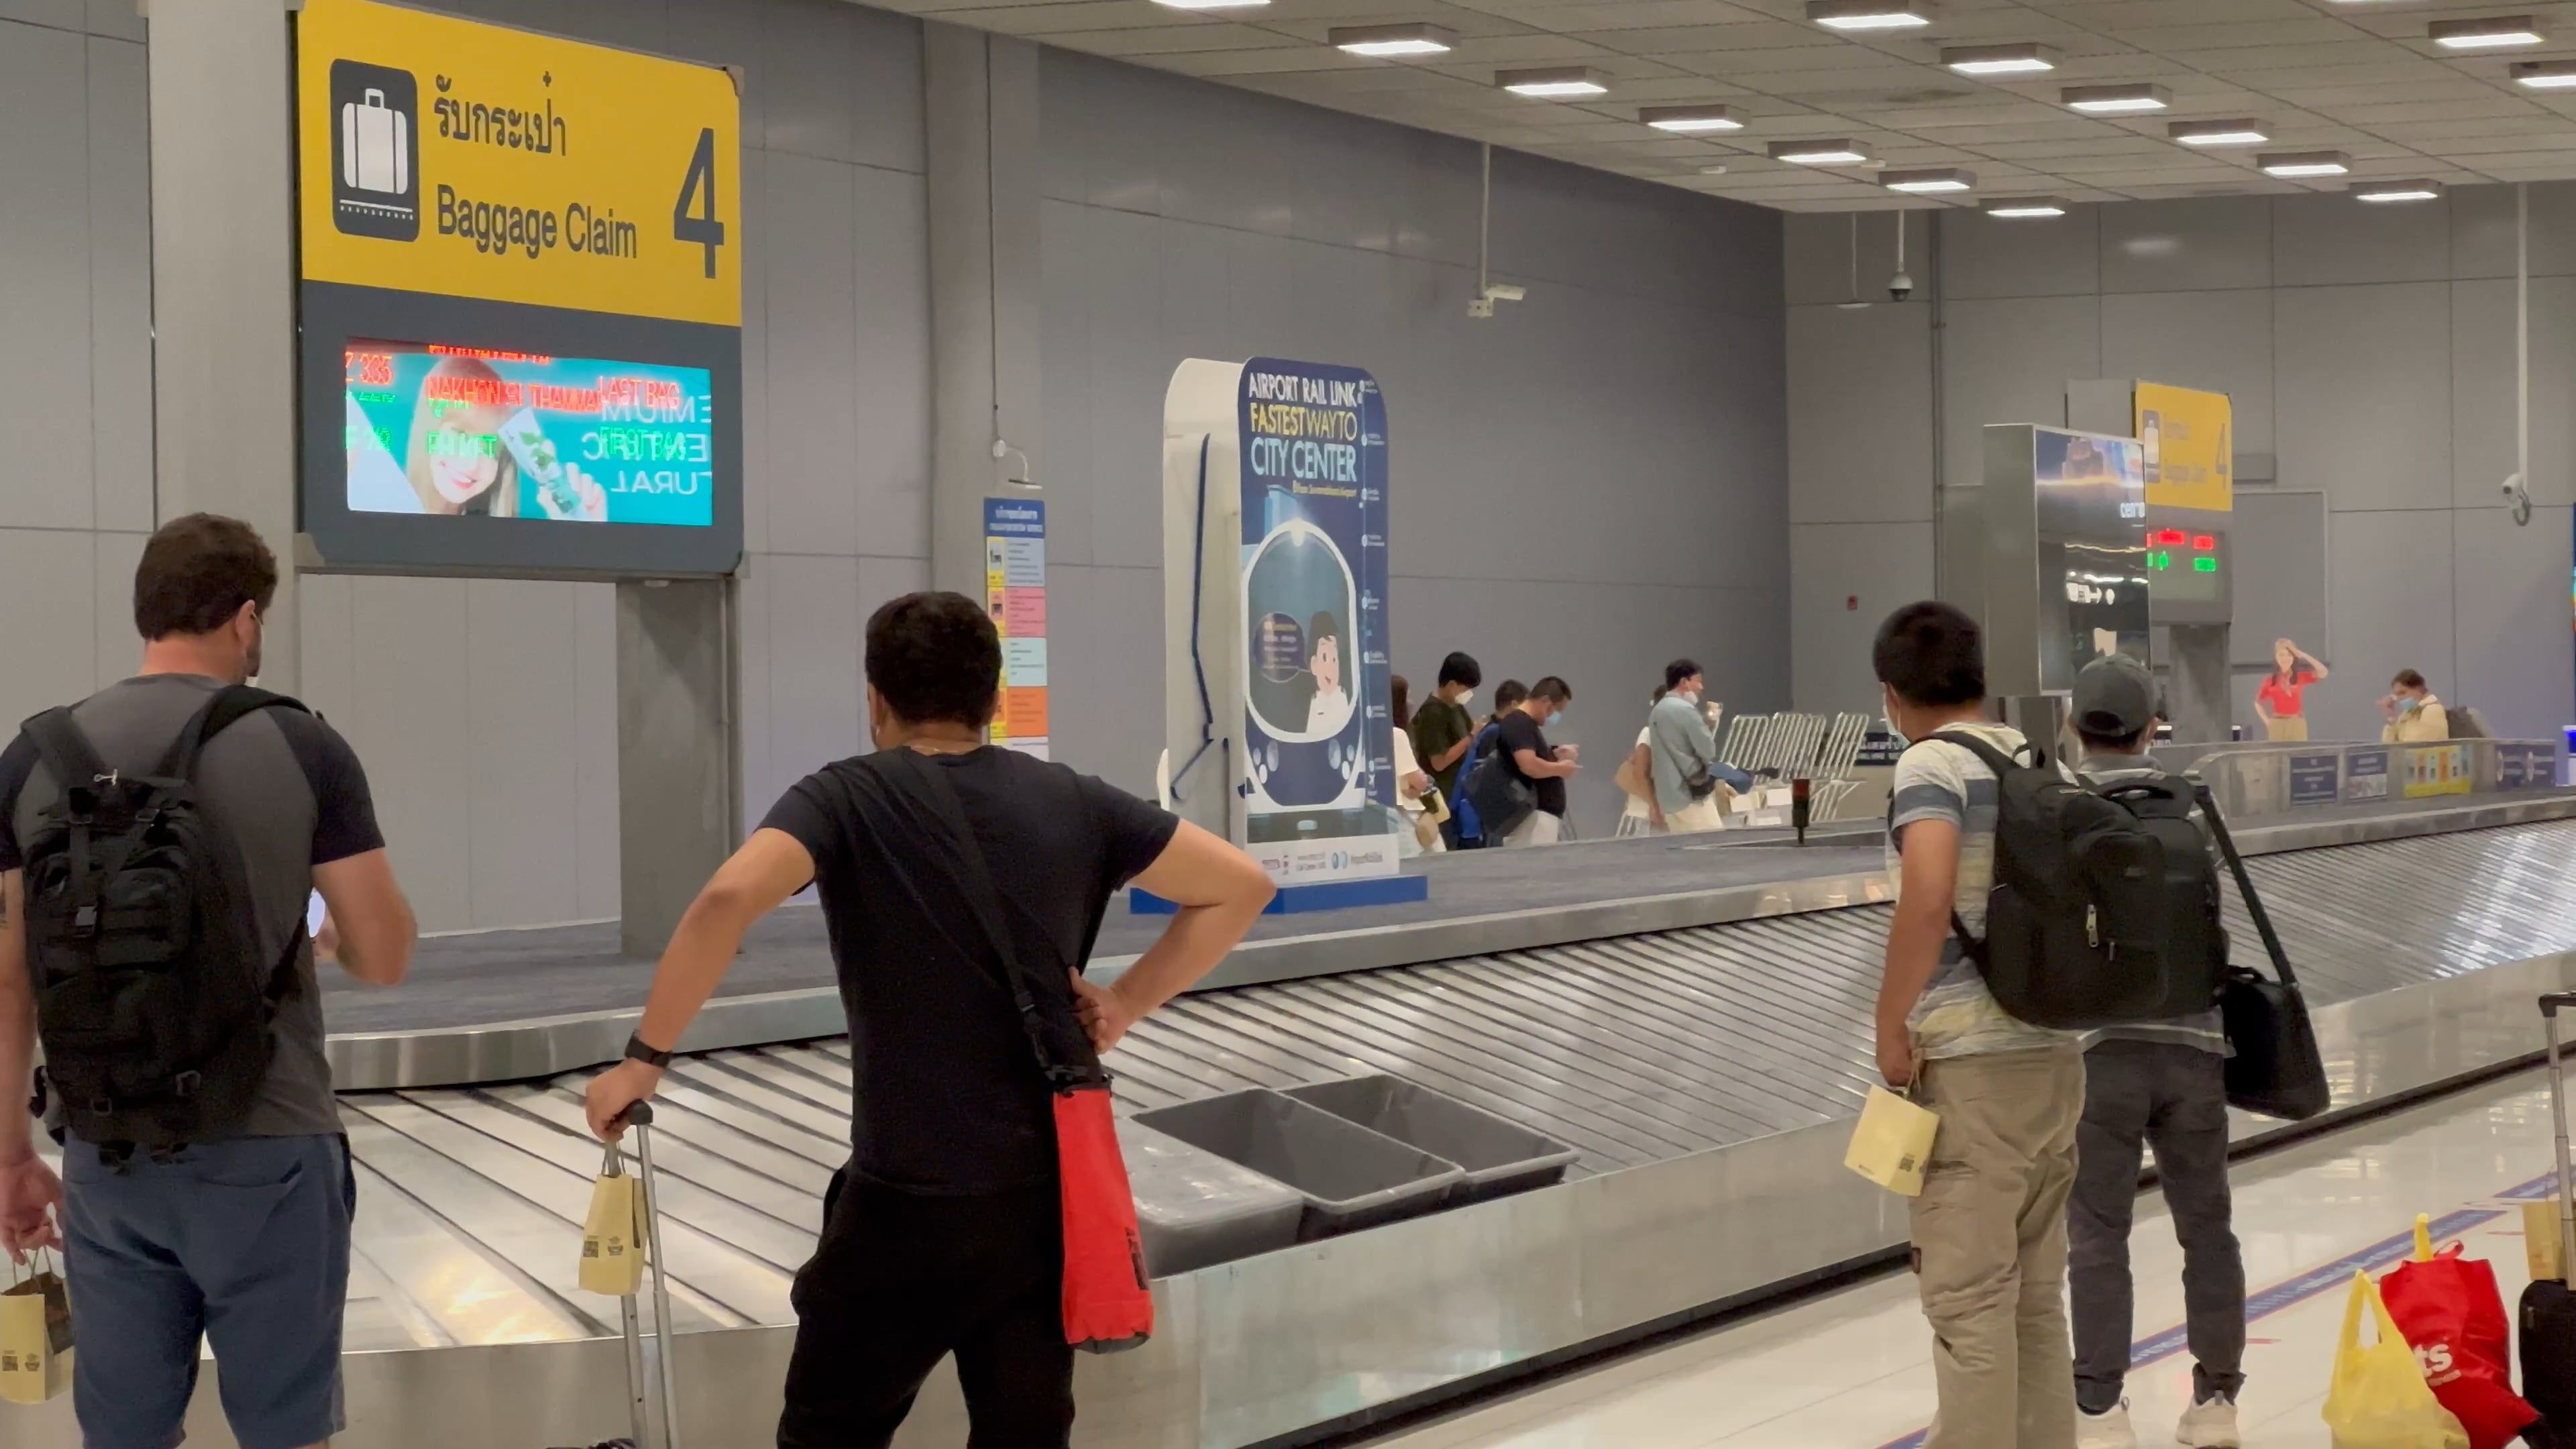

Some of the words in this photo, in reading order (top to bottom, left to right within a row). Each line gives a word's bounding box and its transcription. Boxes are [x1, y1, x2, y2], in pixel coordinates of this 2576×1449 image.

[433, 70, 567, 156] รับกระเป๋า
[437, 184, 557, 260] Baggage
[565, 203, 637, 260] Claim
[674, 127, 724, 279] 4
[598, 376, 641, 406] LAST
[646, 379, 680, 409] BAG
[1248, 372, 1299, 401] AIRPORT
[1302, 377, 1328, 405] RAIL
[1330, 380, 1357, 407] LINK
[1250, 402, 1305, 436] FASTEST
[1250, 437, 1289, 476] CITY
[1291, 441, 1357, 482] CENTER
